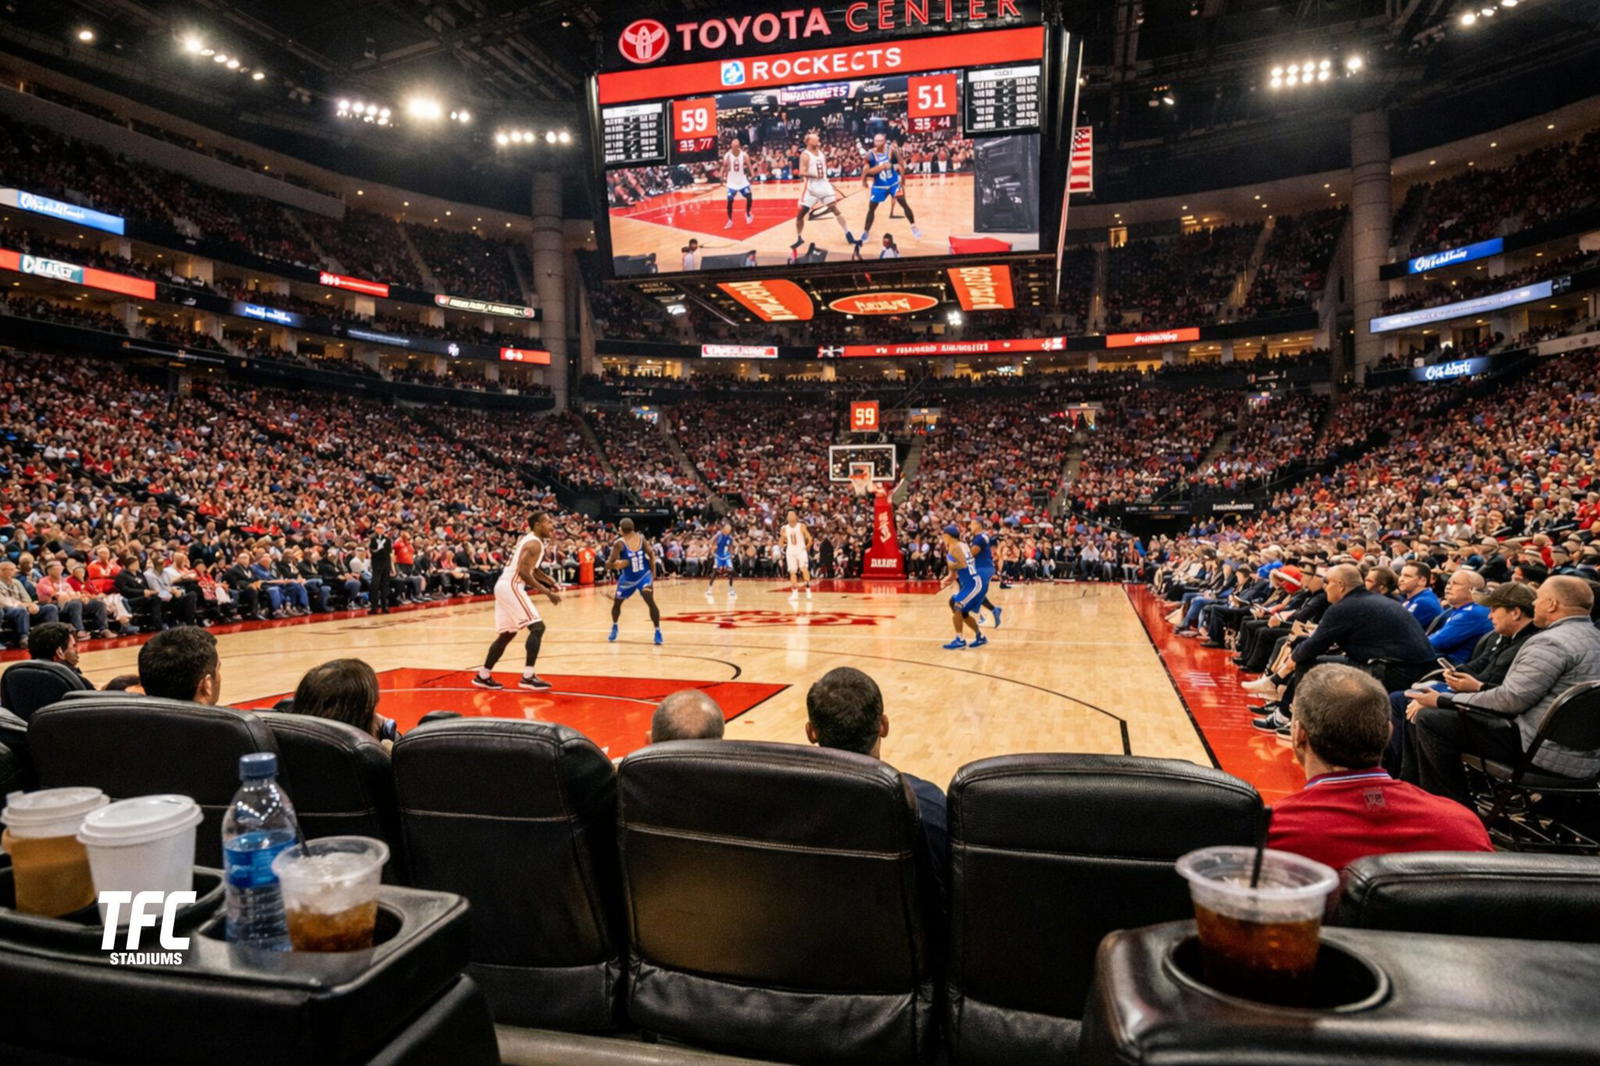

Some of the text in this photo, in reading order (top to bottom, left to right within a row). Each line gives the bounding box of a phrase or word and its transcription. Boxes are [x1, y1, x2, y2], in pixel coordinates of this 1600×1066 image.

[676, 7, 832, 51] TOYOTA
[752, 47, 902, 80] ROCKECTS
[917, 84, 947, 110] 51
[681, 107, 709, 133] 59
